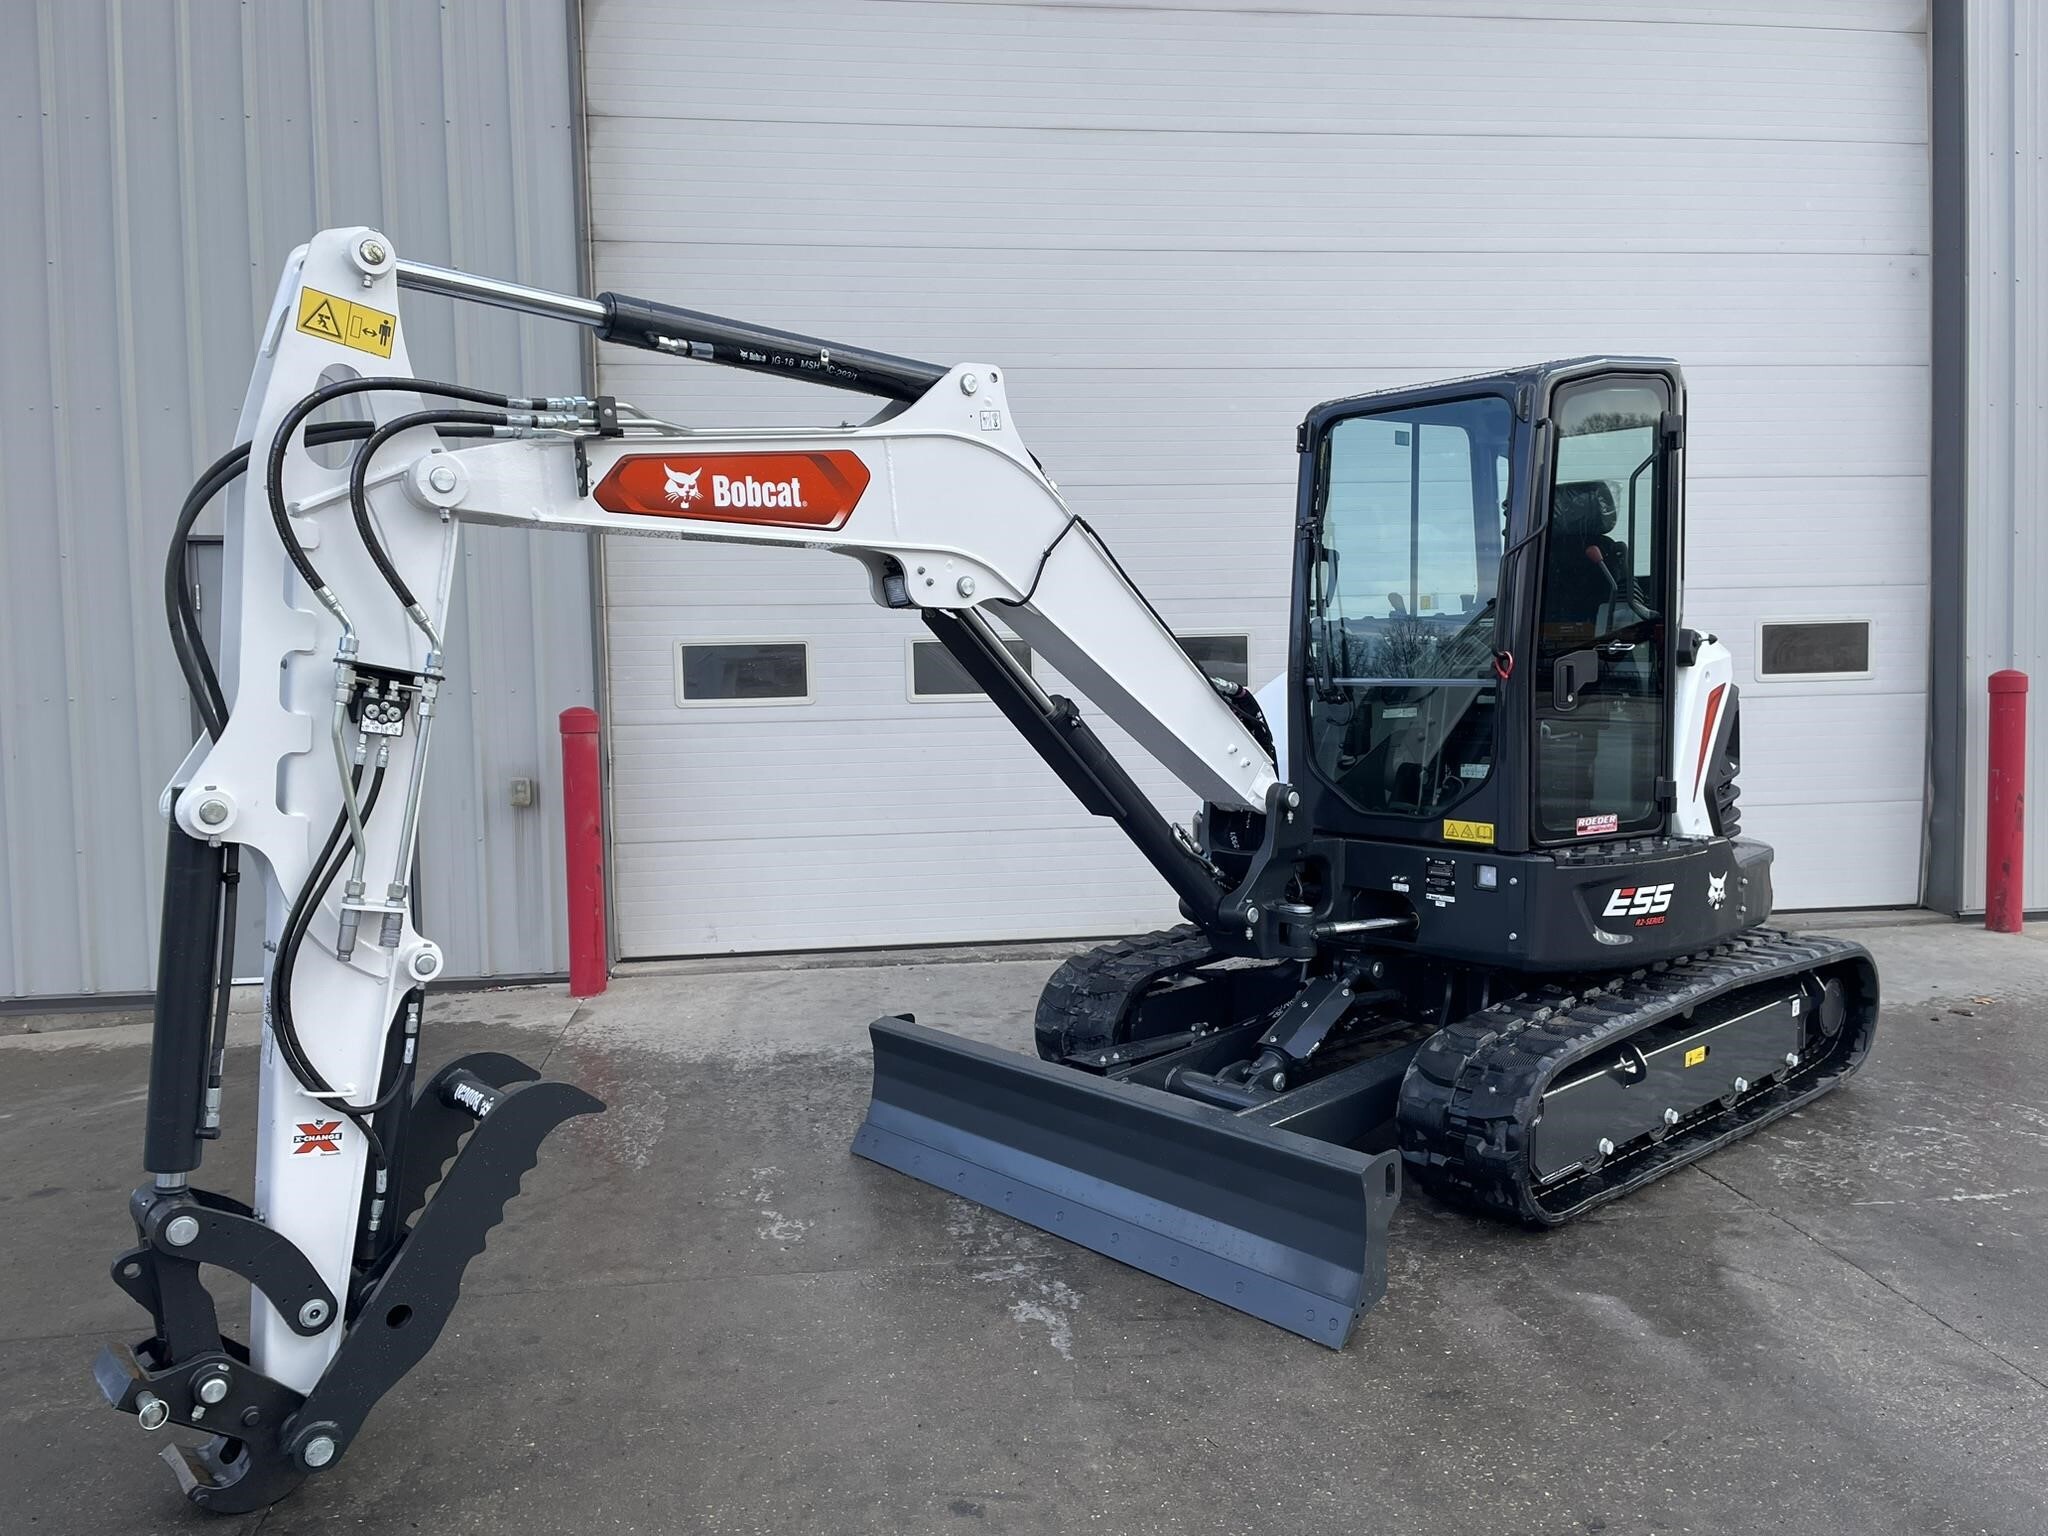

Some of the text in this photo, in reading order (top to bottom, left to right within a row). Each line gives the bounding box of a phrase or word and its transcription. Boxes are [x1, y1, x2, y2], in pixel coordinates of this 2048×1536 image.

[712, 474, 802, 508] Bobcat
[1578, 815, 1617, 826] ROEDER
[453, 1082, 485, 1112] Bobcat
[294, 1133, 342, 1143] X-CHANGE
